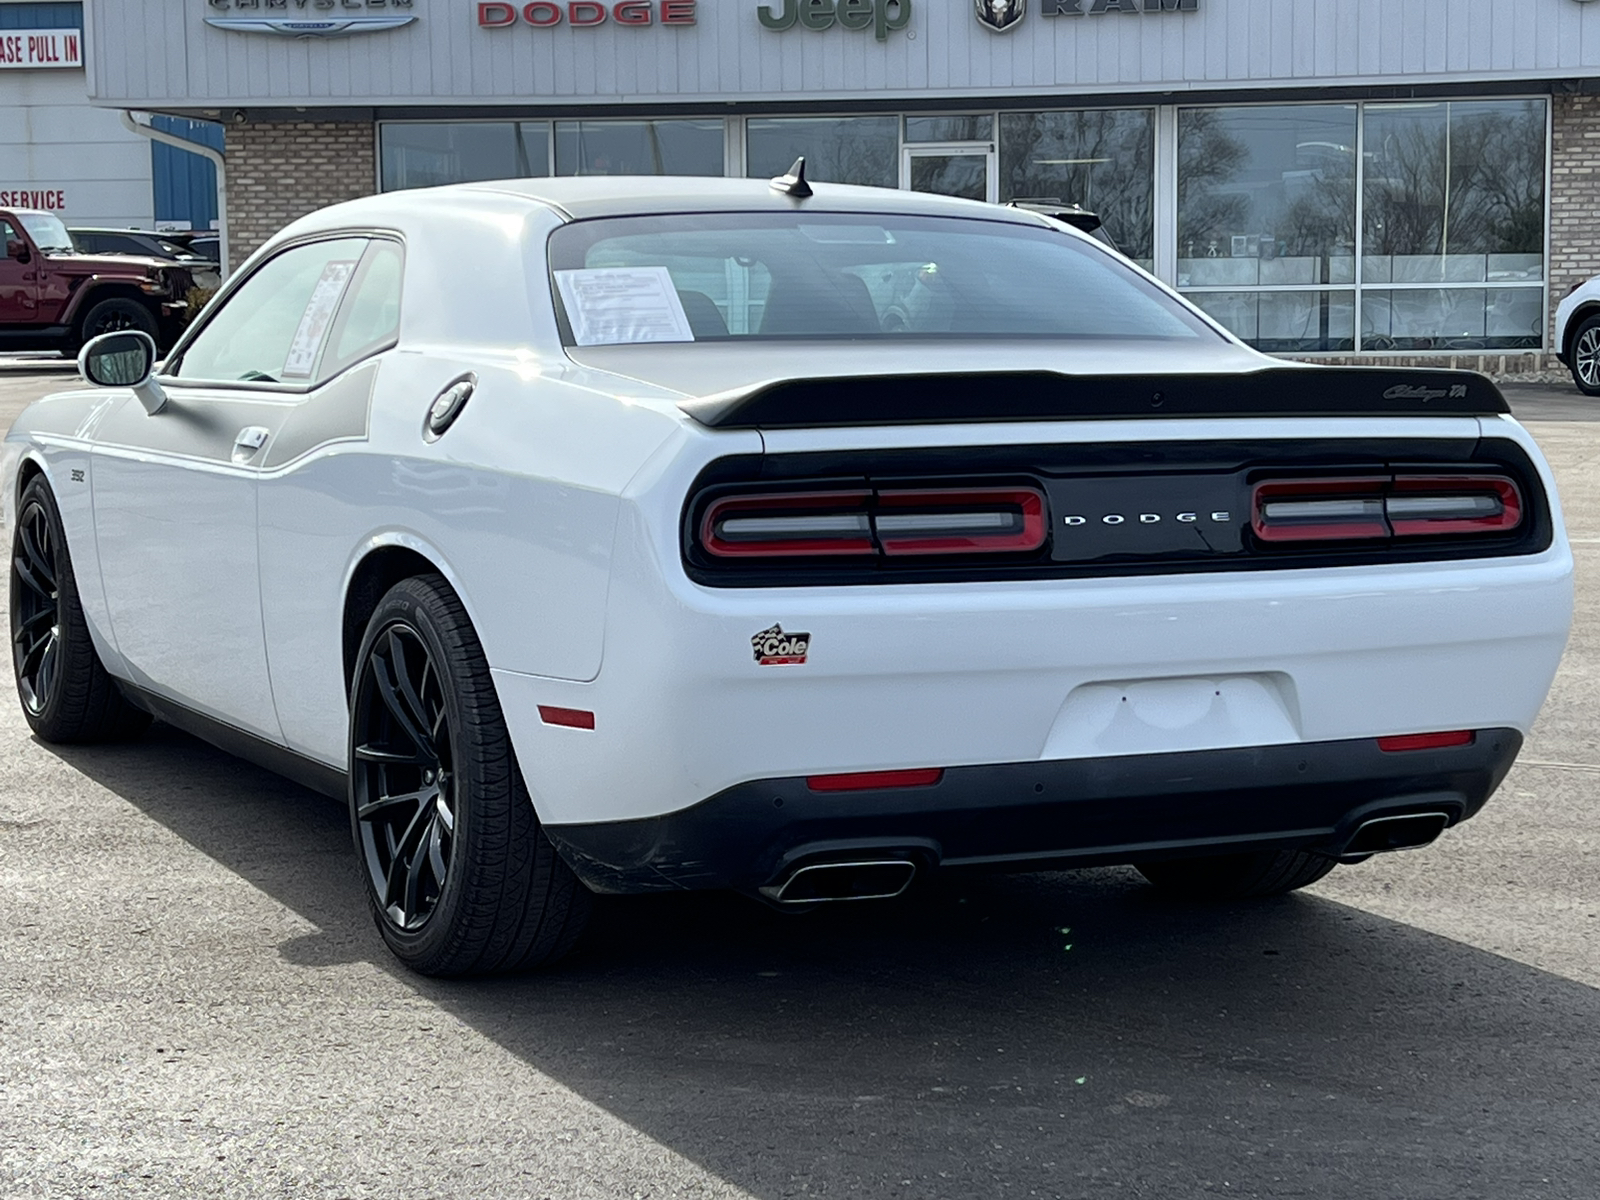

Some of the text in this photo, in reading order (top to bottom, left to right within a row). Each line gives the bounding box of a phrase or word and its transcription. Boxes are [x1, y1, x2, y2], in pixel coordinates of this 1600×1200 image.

[478, 0, 696, 27] DODGE
[757, 0, 912, 41] Jeep
[28, 36, 59, 63] PULL
[64, 35, 78, 62] IN
[0, 190, 66, 210] SERVICE
[1064, 511, 1231, 526] DODGE
[763, 637, 807, 656] Cole
